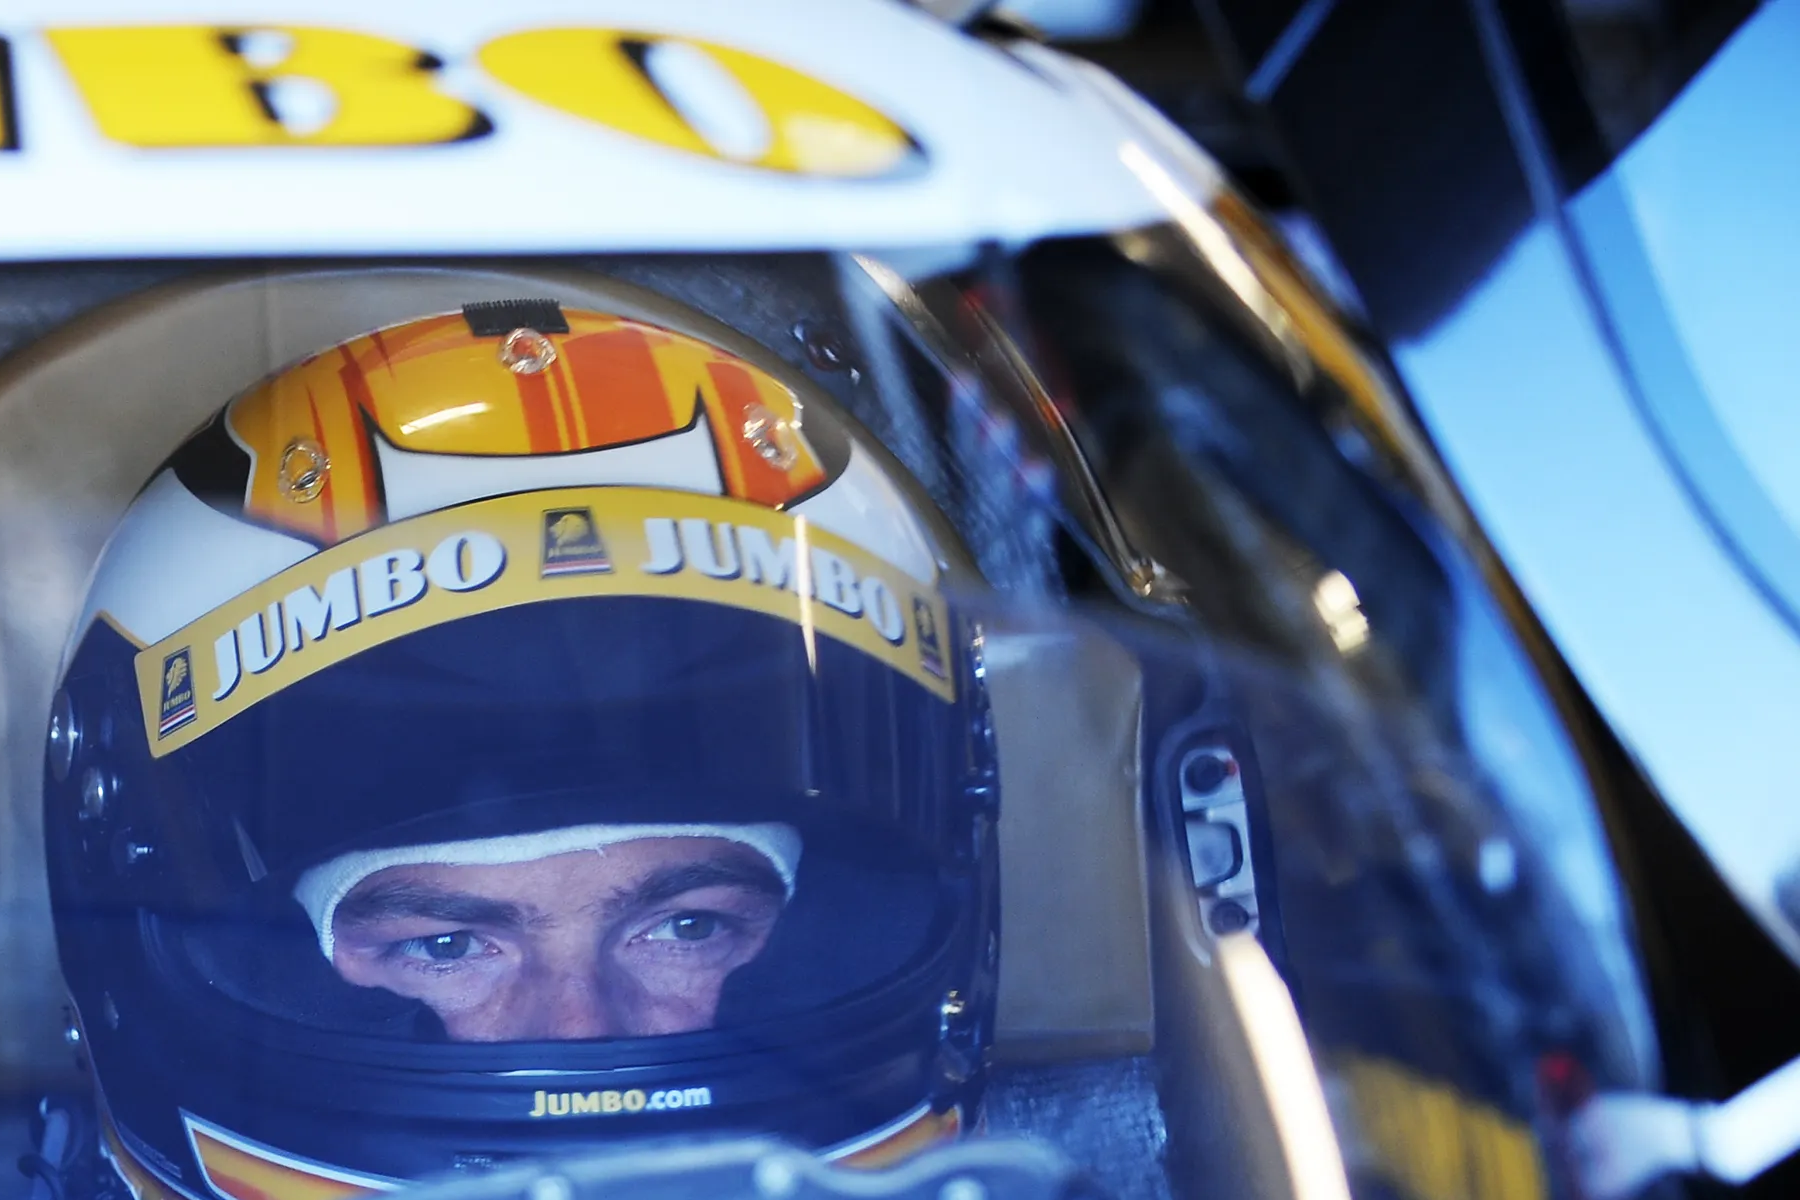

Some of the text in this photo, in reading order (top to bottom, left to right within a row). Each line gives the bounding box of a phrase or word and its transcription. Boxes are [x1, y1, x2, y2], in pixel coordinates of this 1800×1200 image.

[212, 528, 507, 702] JUMBO
[643, 517, 906, 646] JUMBO
[529, 1086, 711, 1117] JUMBO.com
